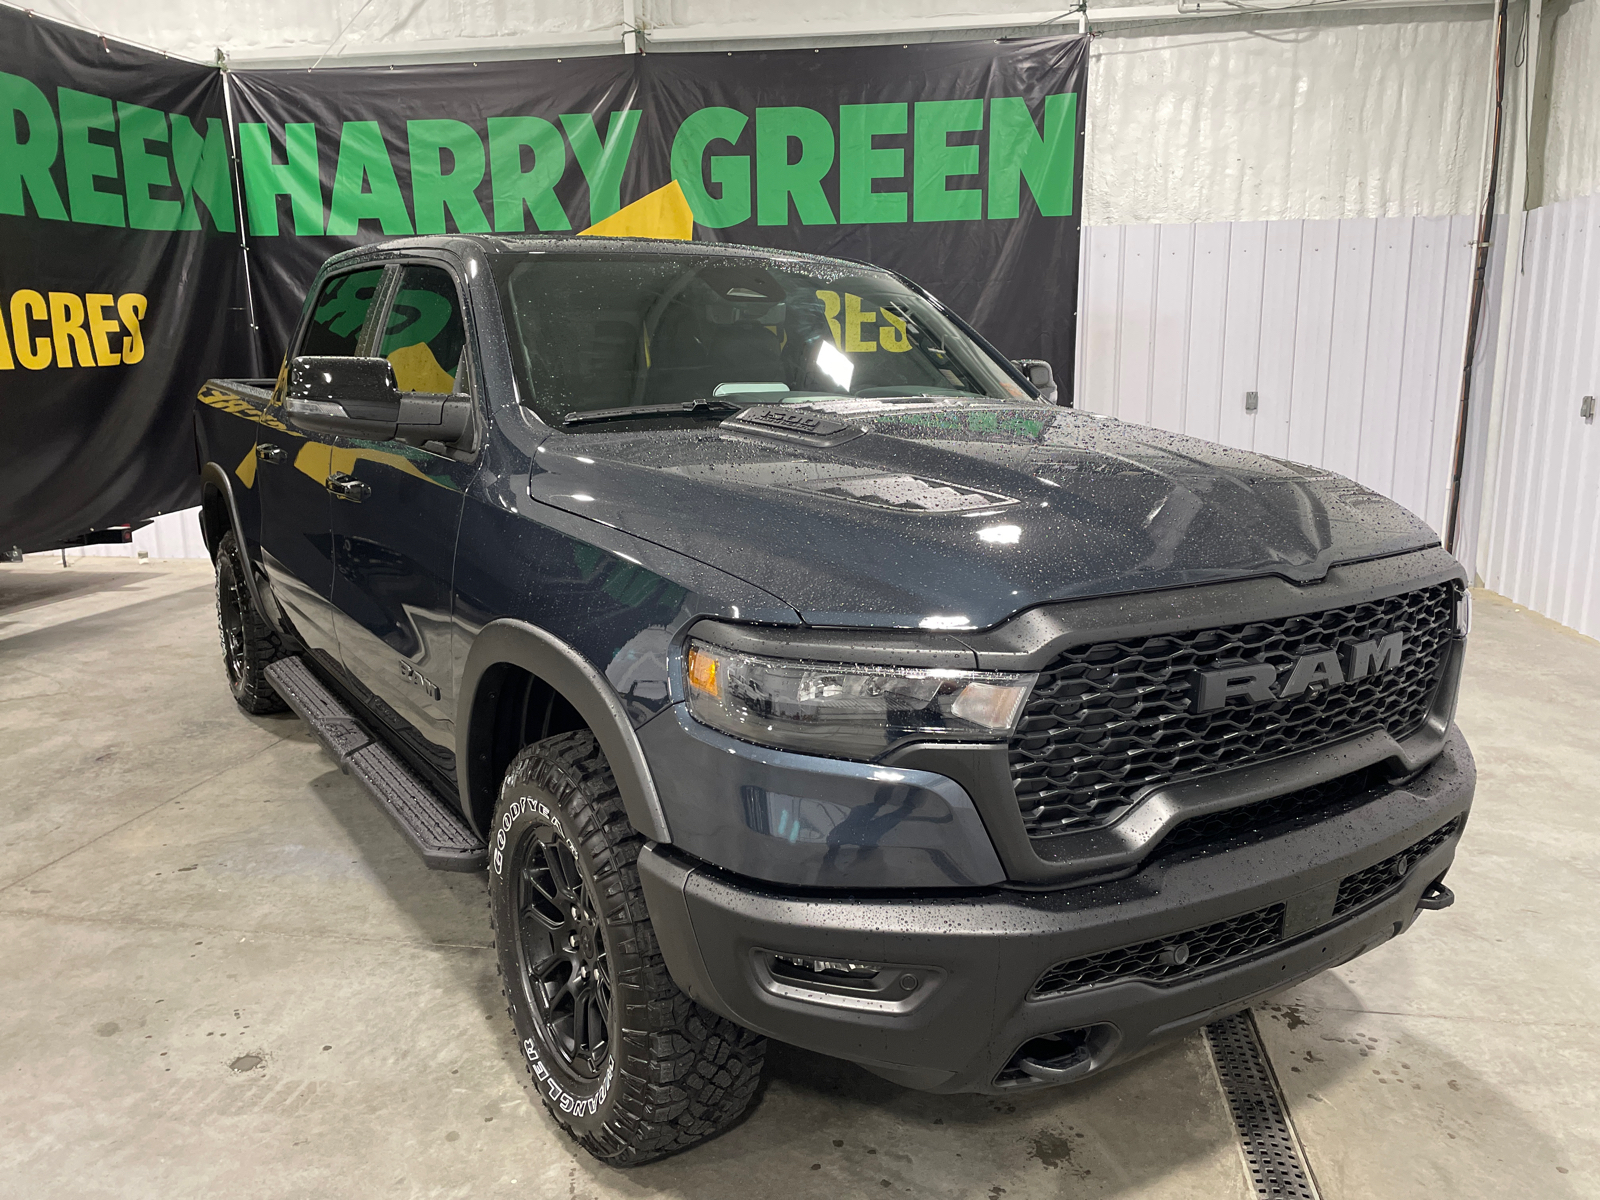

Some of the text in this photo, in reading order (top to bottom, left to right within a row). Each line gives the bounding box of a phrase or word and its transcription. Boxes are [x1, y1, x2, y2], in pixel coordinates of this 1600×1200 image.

[0, 71, 236, 233] REEN
[239, 92, 1077, 236] HARRY GREEN
[1192, 631, 1403, 713] RAM
[494, 797, 579, 875] GOODYEAR
[523, 1038, 615, 1117] WRANGLER
